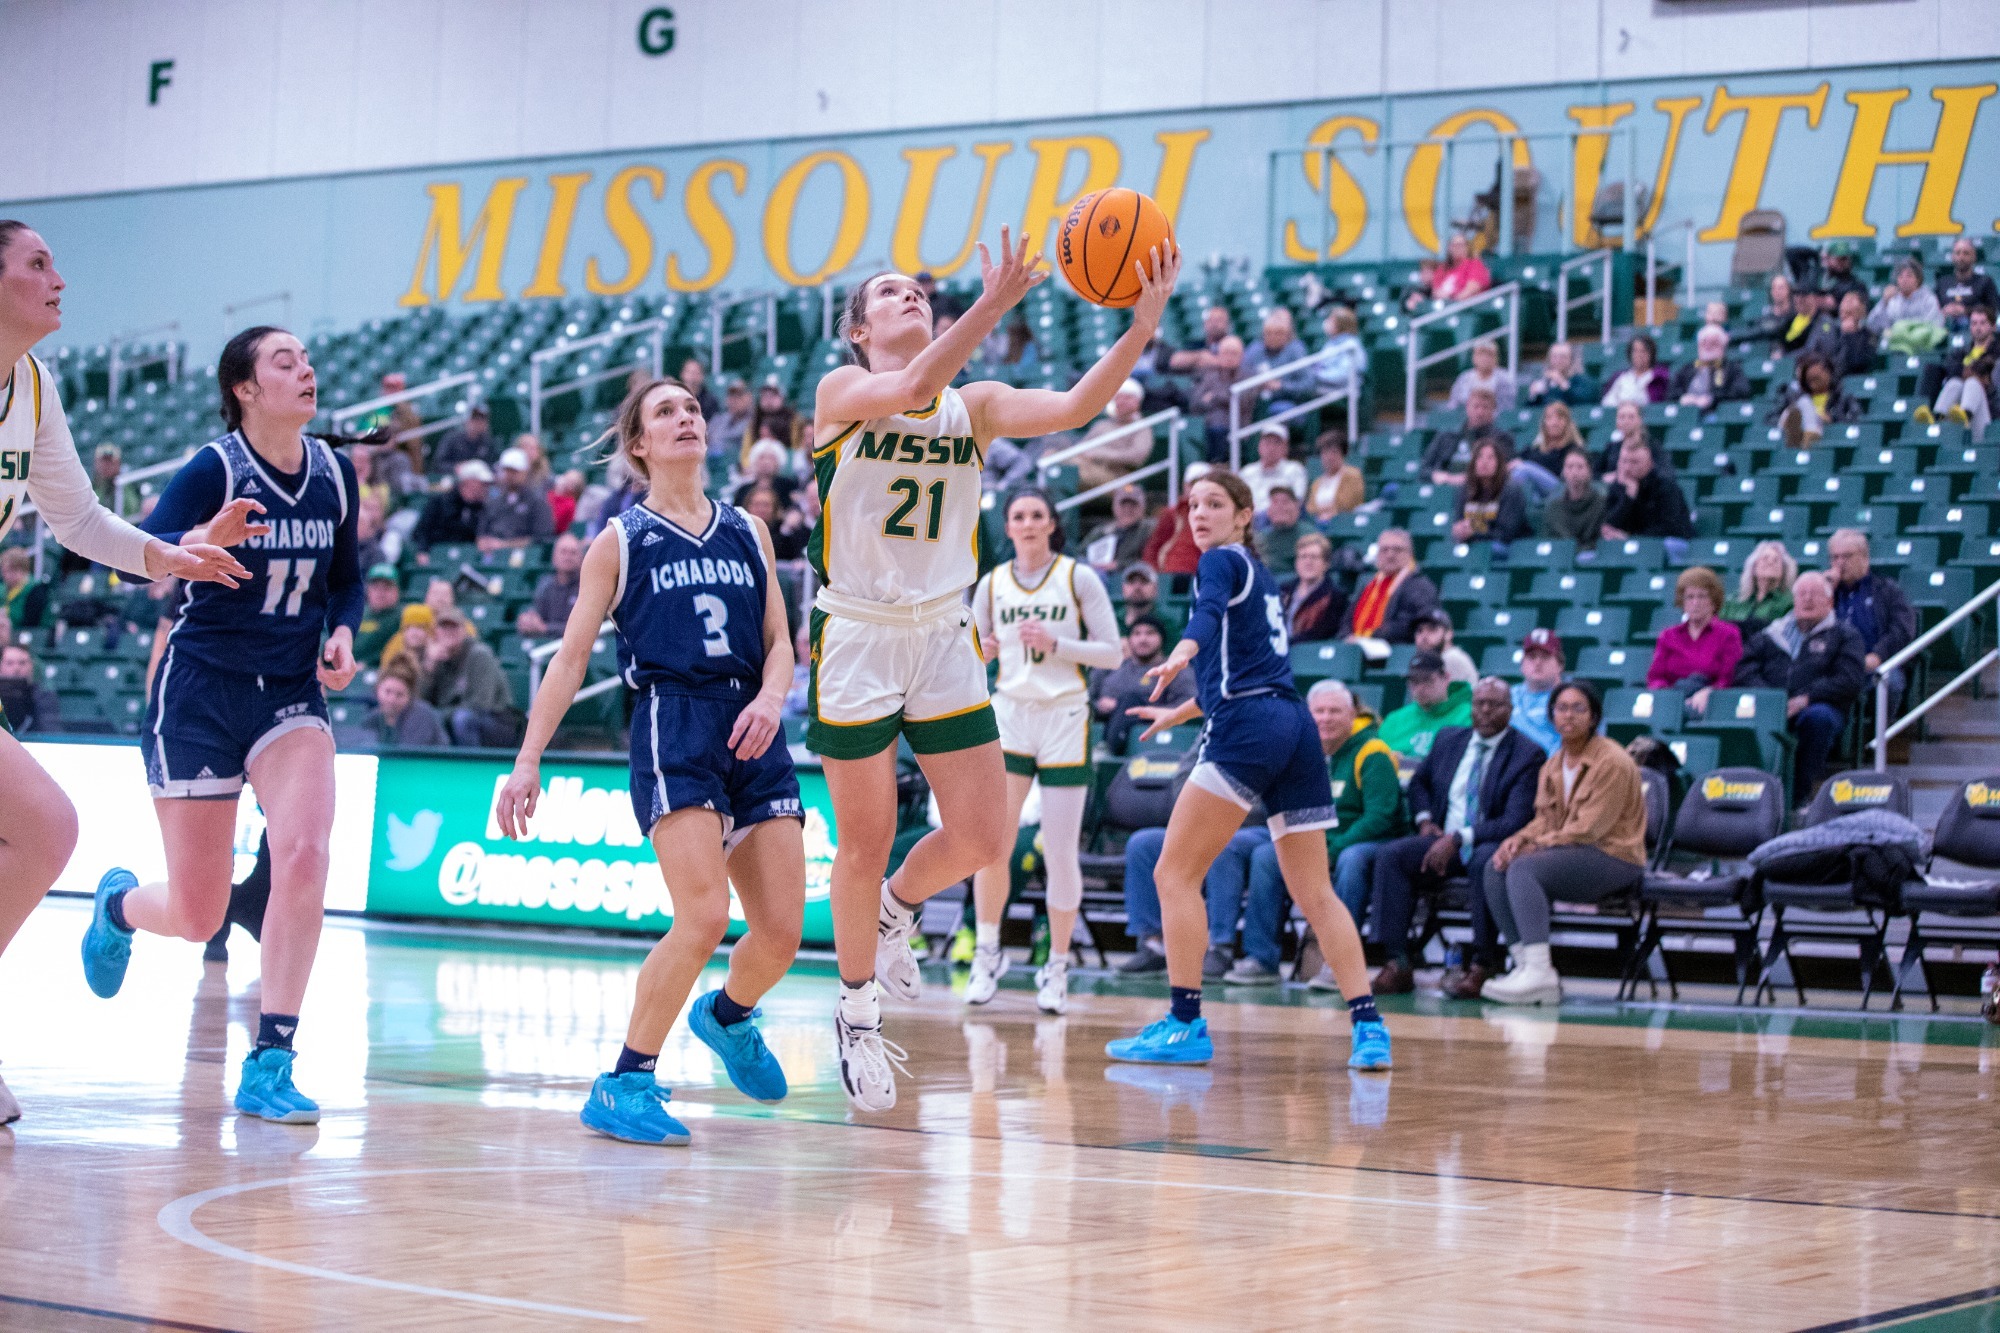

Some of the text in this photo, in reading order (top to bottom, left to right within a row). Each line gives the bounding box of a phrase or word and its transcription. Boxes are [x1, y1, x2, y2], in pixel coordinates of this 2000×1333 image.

[637, 7, 677, 56] G
[147, 59, 175, 105] F
[401, 82, 2000, 307] MISSOURI SOUTH
[855, 431, 976, 467] MSSU
[882, 475, 947, 542] 21
[238, 518, 334, 549] CHABODS
[650, 557, 755, 595] ICHABODS
[692, 592, 732, 657] 3
